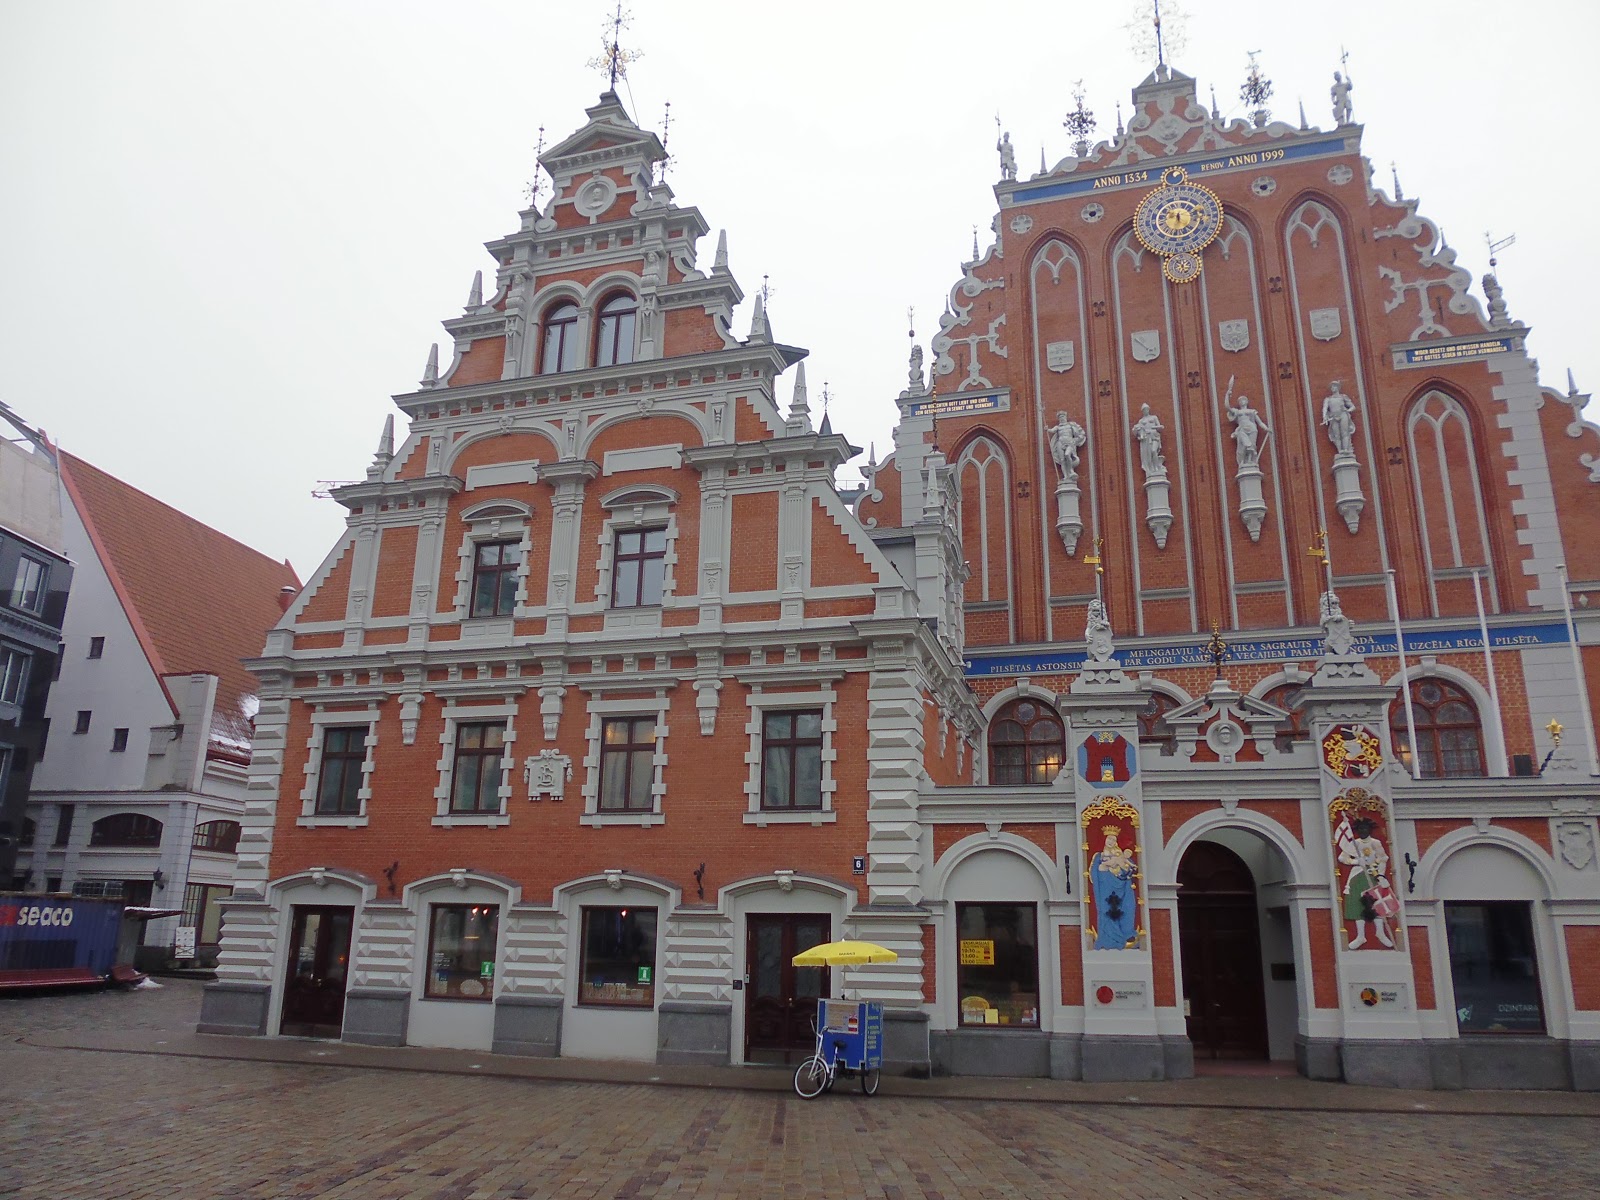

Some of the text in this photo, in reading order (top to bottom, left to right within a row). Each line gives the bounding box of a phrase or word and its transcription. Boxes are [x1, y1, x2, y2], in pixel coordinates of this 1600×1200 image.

[1227, 153, 1257, 168] ANNO
[1261, 149, 1285, 162] 1999
[1093, 170, 1148, 189] ANNO 1334
[1125, 657, 1142, 666] PAR
[1147, 656, 1176, 665] GODU
[1237, 650, 1286, 660] VECAJIEM
[1291, 648, 1324, 657] PAMAT
[1349, 645, 1365, 654] NO
[1371, 643, 1397, 653] JAUN
[1129, 647, 1194, 658] MELNGALVJU
[1230, 643, 1256, 652] TIKA
[1260, 640, 1312, 650] SAGRAUTS
[855, 860, 861, 868] 6
[17, 906, 73, 926] seaco
